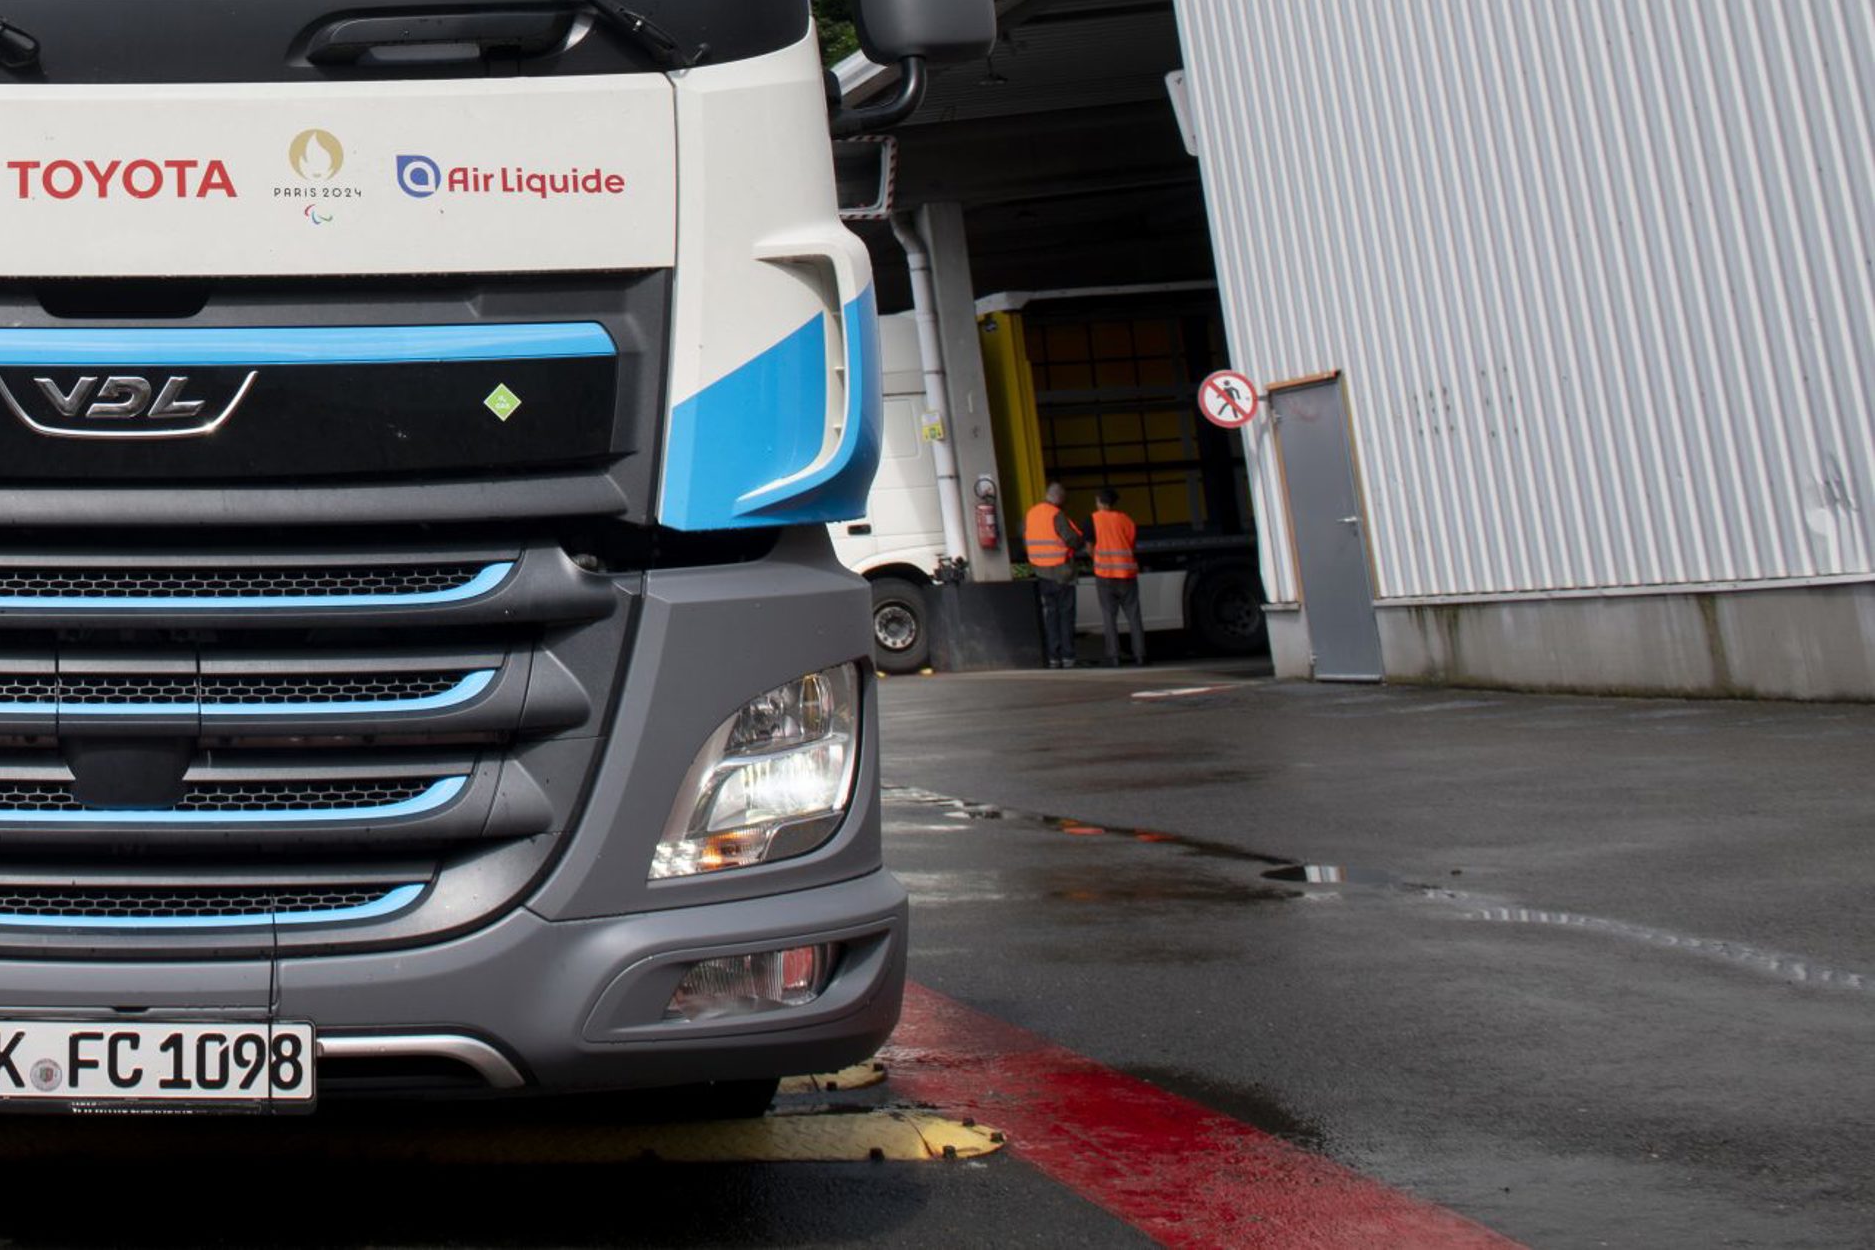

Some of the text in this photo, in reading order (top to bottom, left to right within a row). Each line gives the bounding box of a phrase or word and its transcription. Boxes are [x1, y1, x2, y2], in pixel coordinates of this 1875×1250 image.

[7, 158, 238, 200] TOYOTA
[321, 186, 362, 198] 2024
[448, 167, 625, 200] Air Liquide
[33, 375, 206, 418] VDL
[68, 1032, 143, 1088] FC
[159, 1032, 303, 1090] 1098
